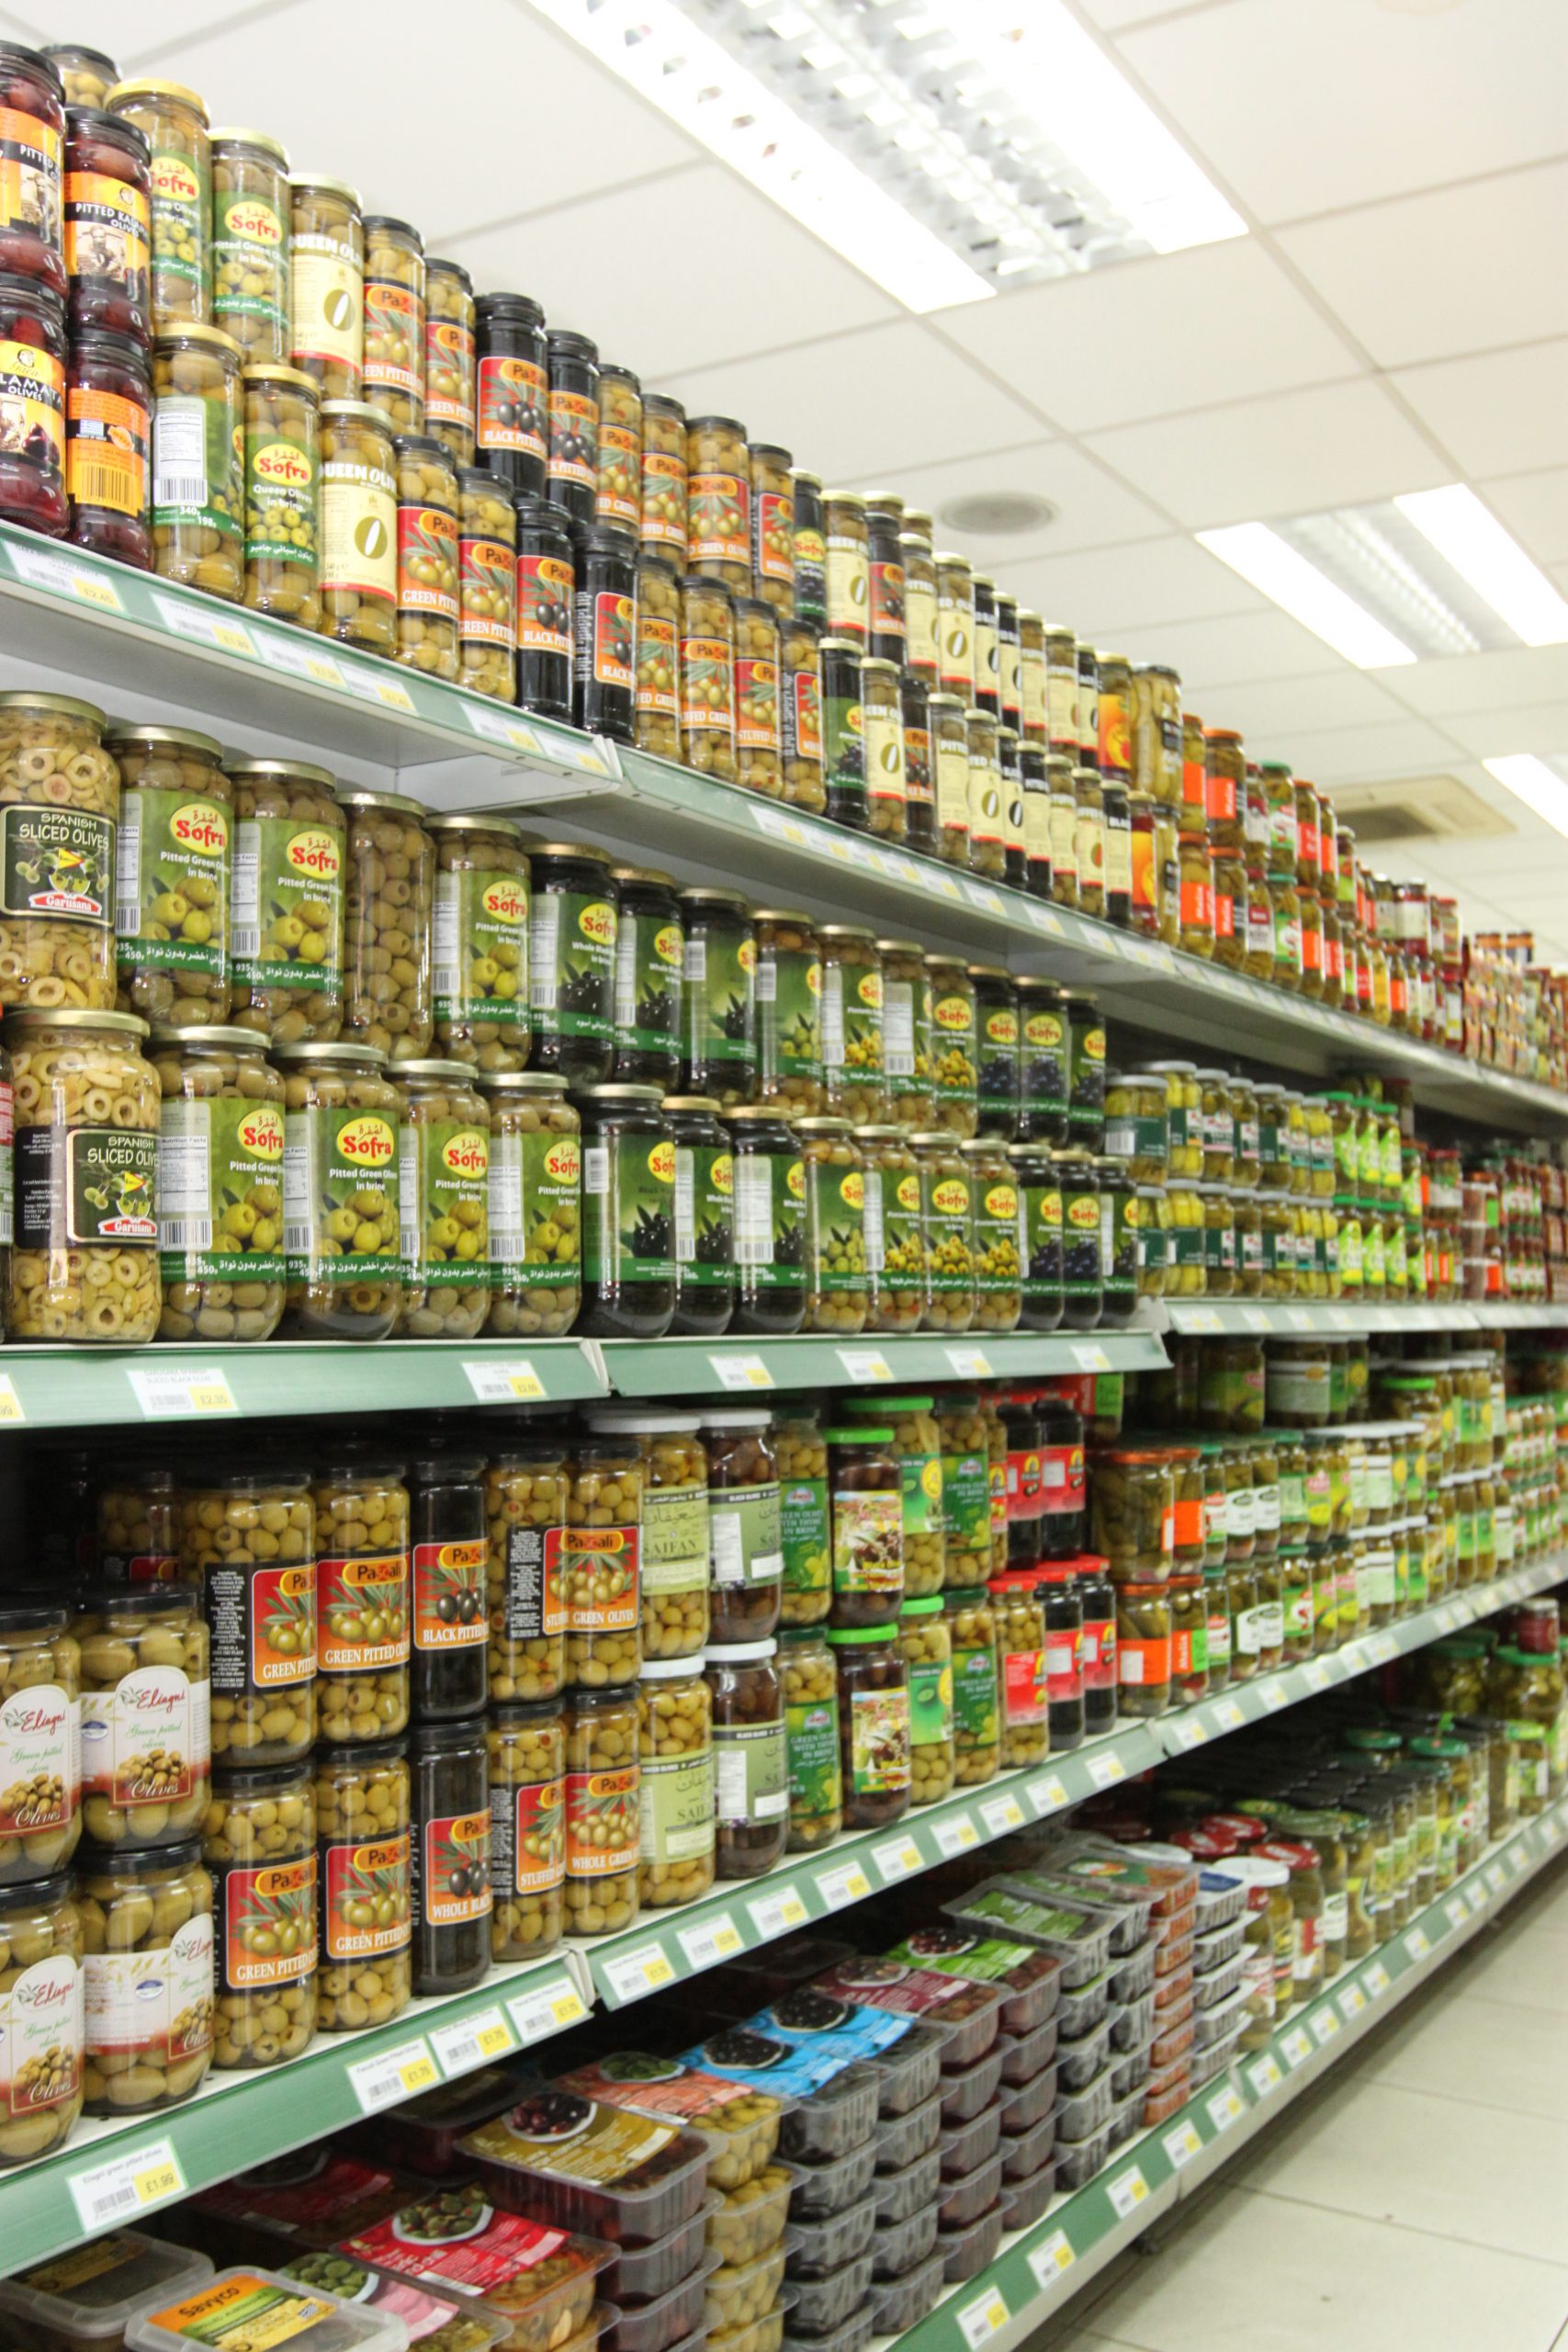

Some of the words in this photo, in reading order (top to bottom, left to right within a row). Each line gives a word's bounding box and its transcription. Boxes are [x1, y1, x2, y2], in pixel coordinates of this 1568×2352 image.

[76, 203, 115, 219] PITTED
[231, 216, 279, 241] Sofra
[8, 386, 42, 401] OLIVES
[484, 430, 513, 444] BLACK
[258, 458, 310, 481] Sofra
[253, 484, 288, 495] Queen
[288, 486, 313, 504] Olives
[402, 590, 436, 605] GREEN
[524, 630, 552, 644] BLACK
[40, 813, 96, 831] SPANISH
[19, 824, 69, 841] SLICED
[73, 828, 109, 851] OLIVES
[175, 820, 226, 848] Sofra
[160, 851, 191, 865] Pitted
[191, 855, 216, 869] Green
[292, 847, 339, 873] Sofra
[187, 867, 197, 877] in
[277, 876, 305, 889] Pitted
[306, 878, 331, 891] Green
[46, 896, 93, 912] Garusana
[487, 897, 527, 919] Sofra
[108, 1136, 154, 1149] SPANISH
[243, 1126, 284, 1153] Sofra
[343, 1136, 393, 1159] Sofra
[87, 1148, 133, 1165] SLICED
[230, 1160, 257, 1171] Pitted
[447, 1148, 487, 1172] Sofra
[255, 1176, 263, 1186] in
[329, 1168, 359, 1179] Pitted
[359, 1169, 383, 1180] Green
[355, 1181, 365, 1192] in
[366, 1182, 386, 1193] brine
[434, 1180, 460, 1191] Pitted
[537, 1186, 560, 1195] Pitted
[935, 1191, 969, 1210] Sofra
[573, 1610, 604, 1626] GREEN
[607, 1608, 635, 1624] OLIVES
[423, 1627, 457, 1644] BLACK
[457, 1624, 483, 1641] PITTED
[325, 1648, 362, 1666] GREEN
[363, 1644, 395, 1661] PITTED
[263, 1663, 298, 1680] GREEN
[130, 1777, 180, 1799] Olives
[15, 1805, 62, 1828] Olives
[571, 1855, 606, 1871] WHOLE
[608, 1852, 633, 1868] GREEN
[433, 1903, 468, 1918] WHOLE
[336, 1935, 372, 1952] GREEN
[374, 1928, 401, 1947] PITTED
[236, 1962, 276, 1982] GREEN
[277, 1955, 309, 1974] PITTED
[407, 2065, 432, 2083] £1.75
[29, 2080, 72, 2104] Olives
[145, 2172, 175, 2194] £1.99
